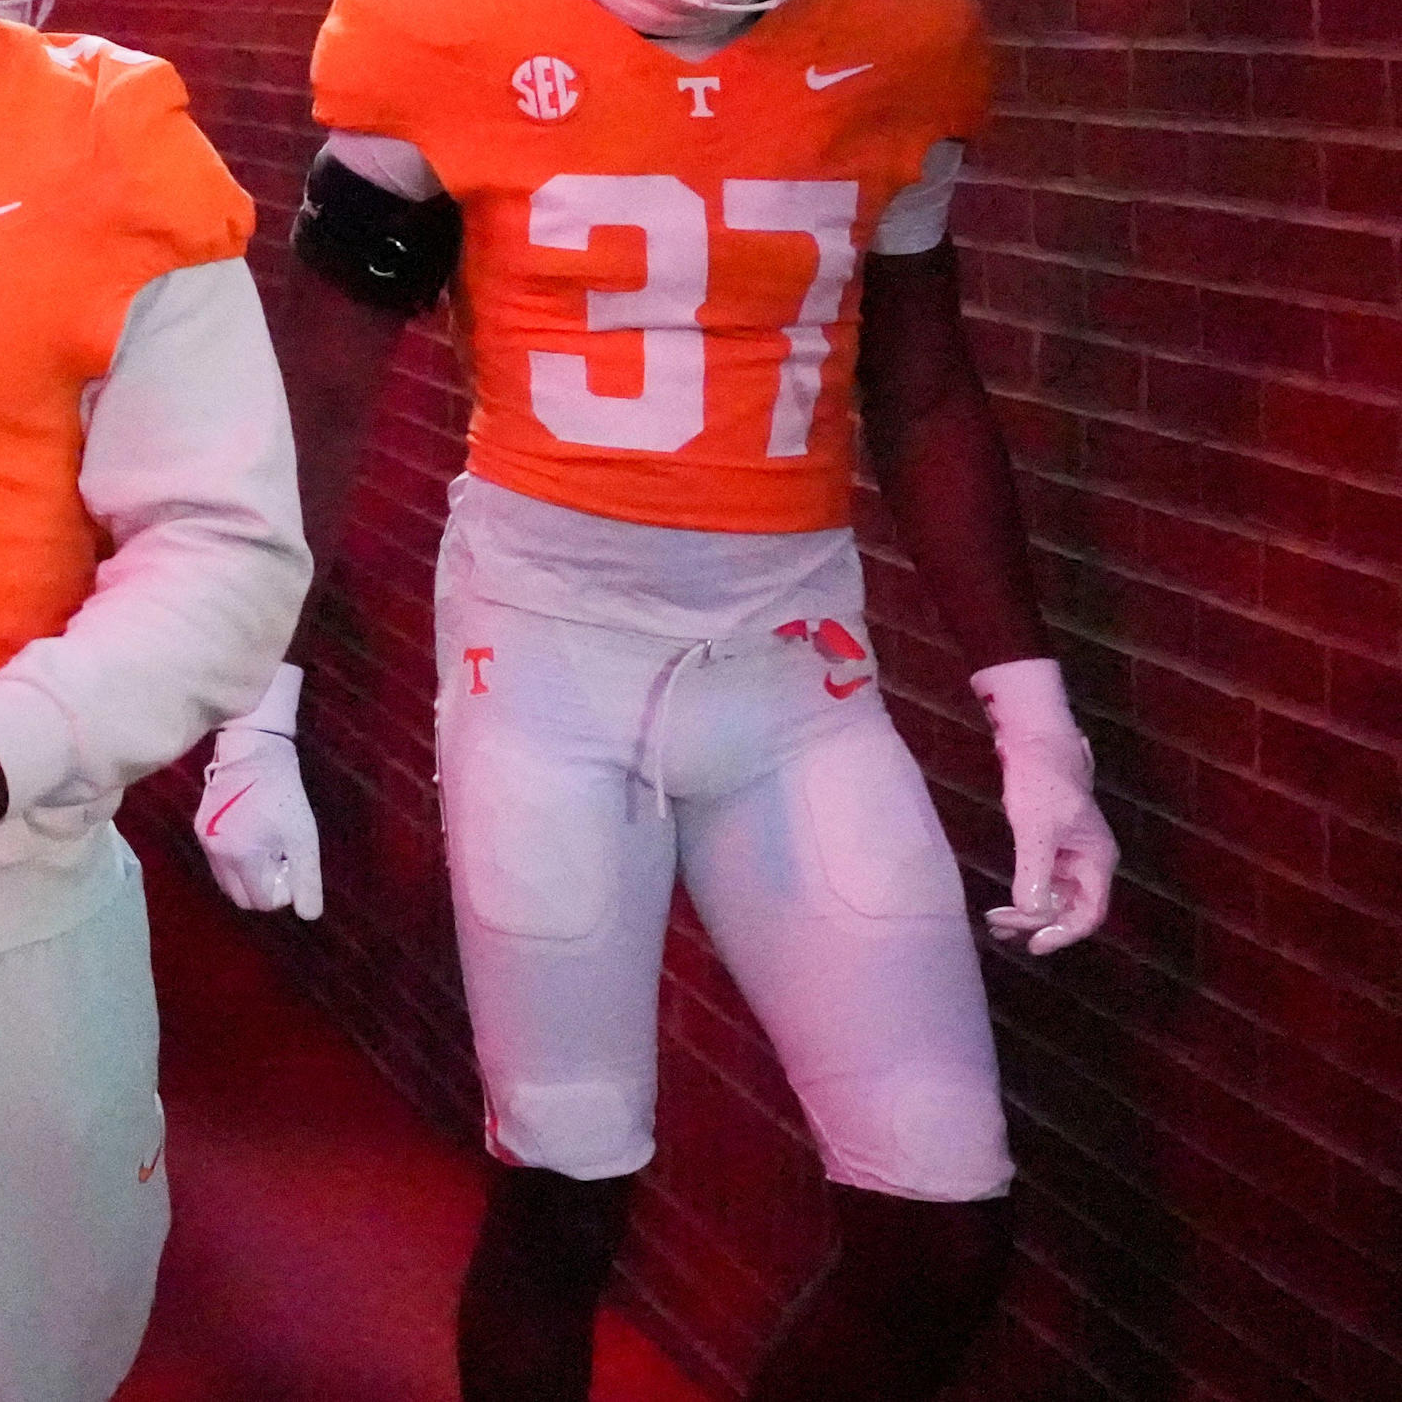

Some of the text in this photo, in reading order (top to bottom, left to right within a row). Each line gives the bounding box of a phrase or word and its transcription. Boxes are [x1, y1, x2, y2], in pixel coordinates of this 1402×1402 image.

[511, 55, 581, 121] SEC
[677, 76, 721, 119] T
[528, 174, 859, 458] 37
[463, 647, 495, 696] T
